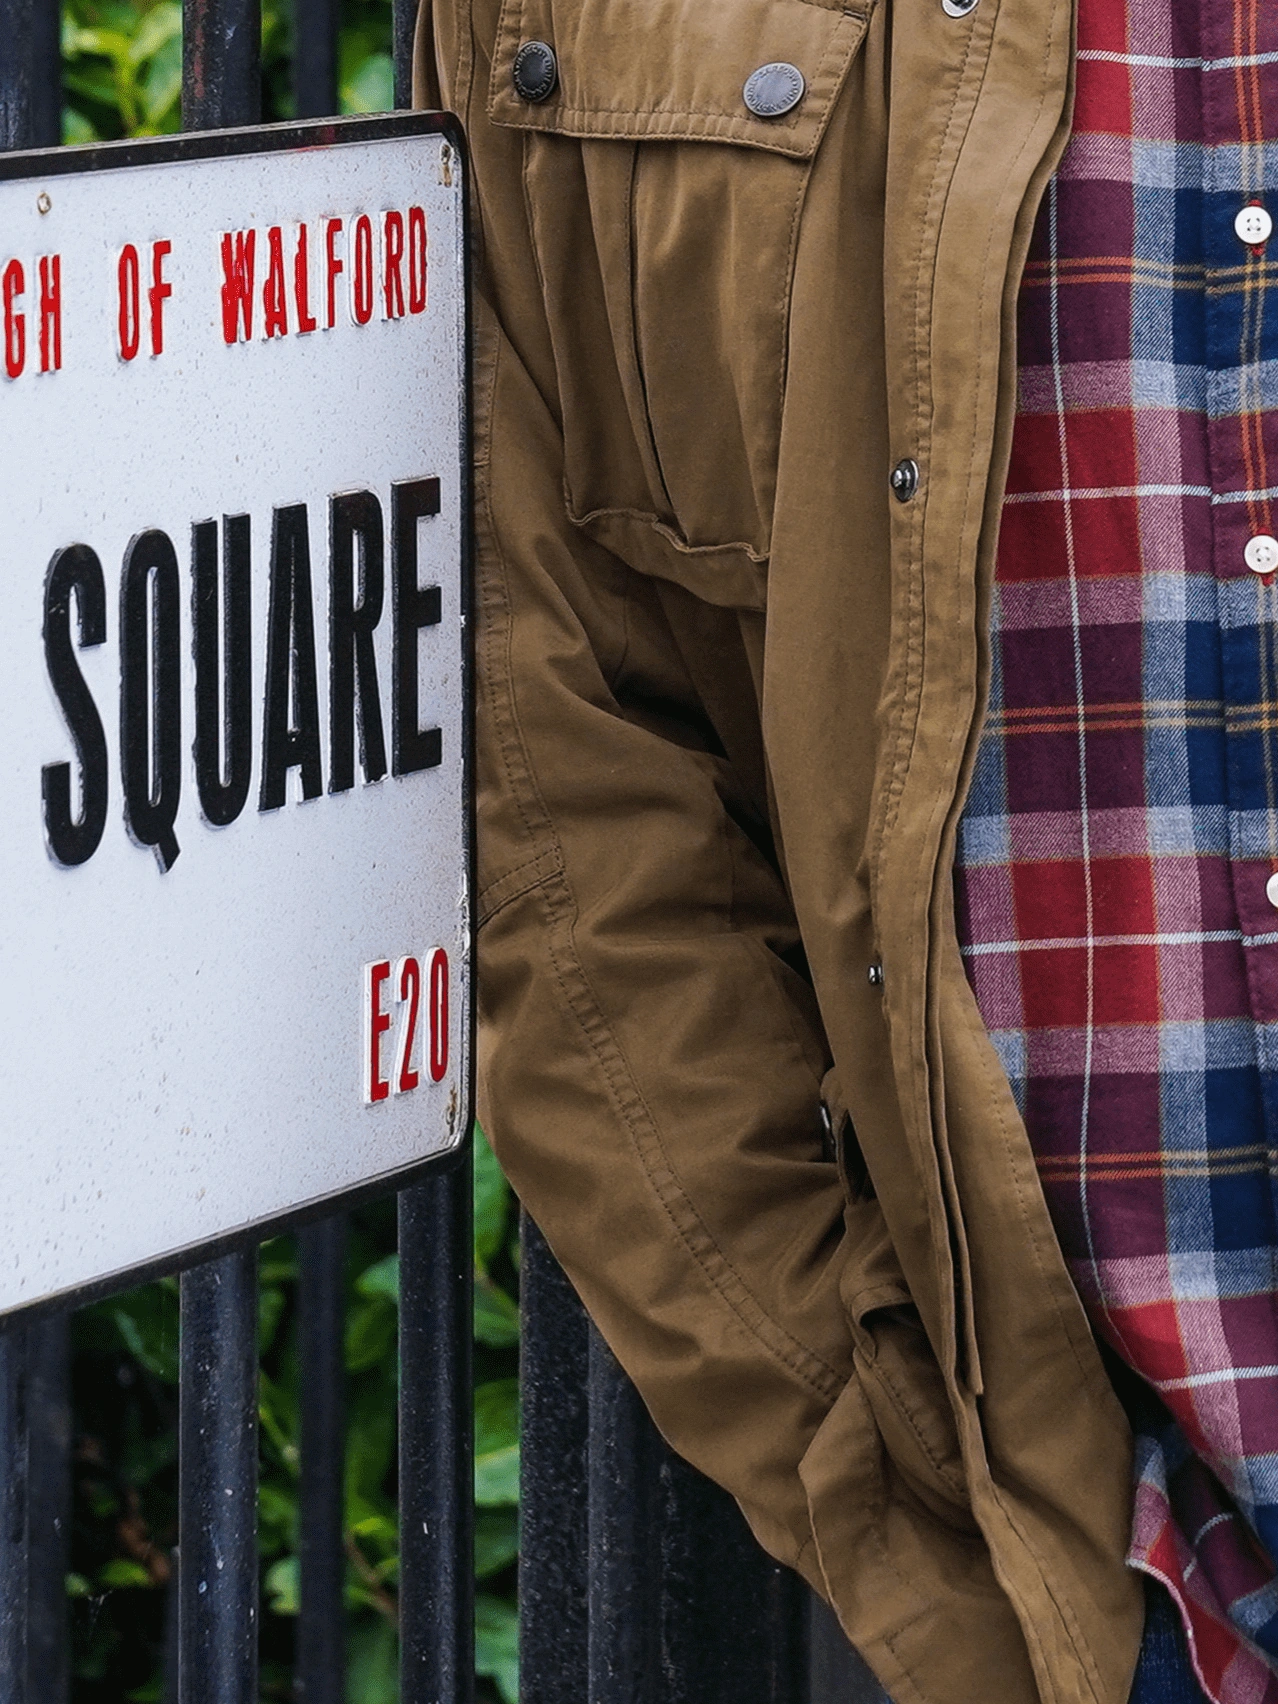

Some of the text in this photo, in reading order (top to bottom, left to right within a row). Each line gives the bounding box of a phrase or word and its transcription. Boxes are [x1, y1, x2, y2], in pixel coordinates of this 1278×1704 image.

[2, 206, 428, 379] GH OF WALFORD
[42, 475, 443, 873] SQUARE
[369, 948, 450, 1103] E20
